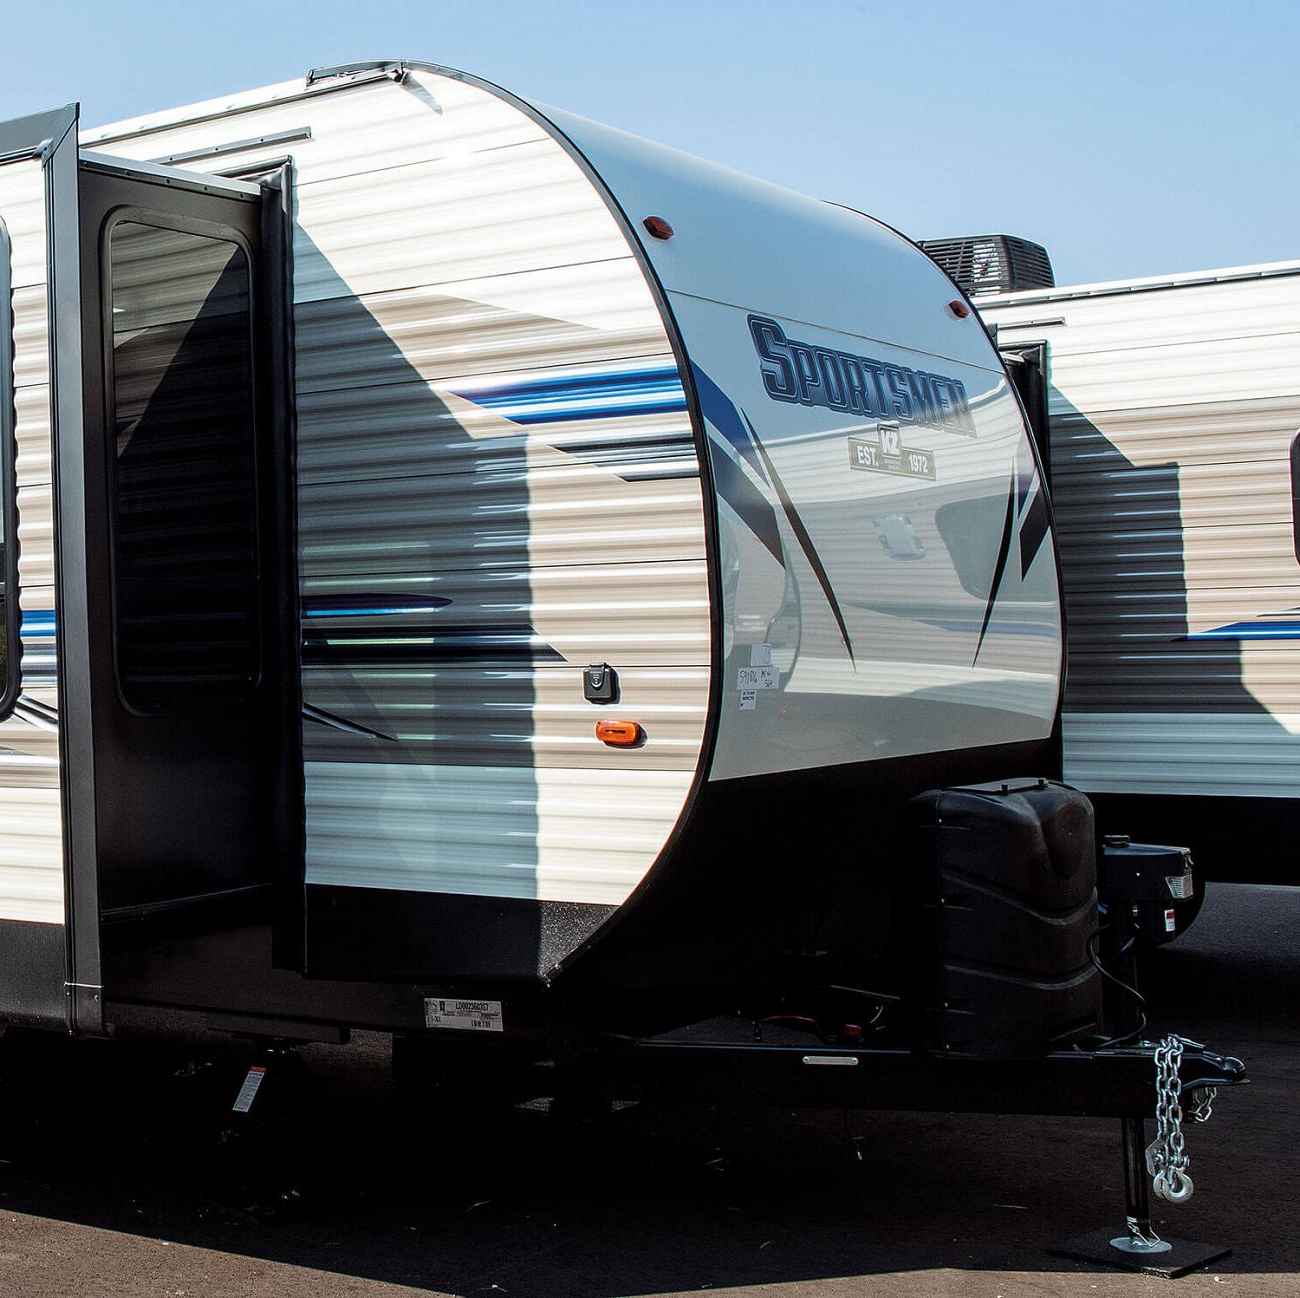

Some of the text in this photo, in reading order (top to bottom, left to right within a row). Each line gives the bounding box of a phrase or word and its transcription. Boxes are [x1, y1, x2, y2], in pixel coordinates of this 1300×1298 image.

[747, 314, 978, 438] SPORTSMEN
[857, 446, 879, 466] EST.
[908, 454, 929, 473] 1972
